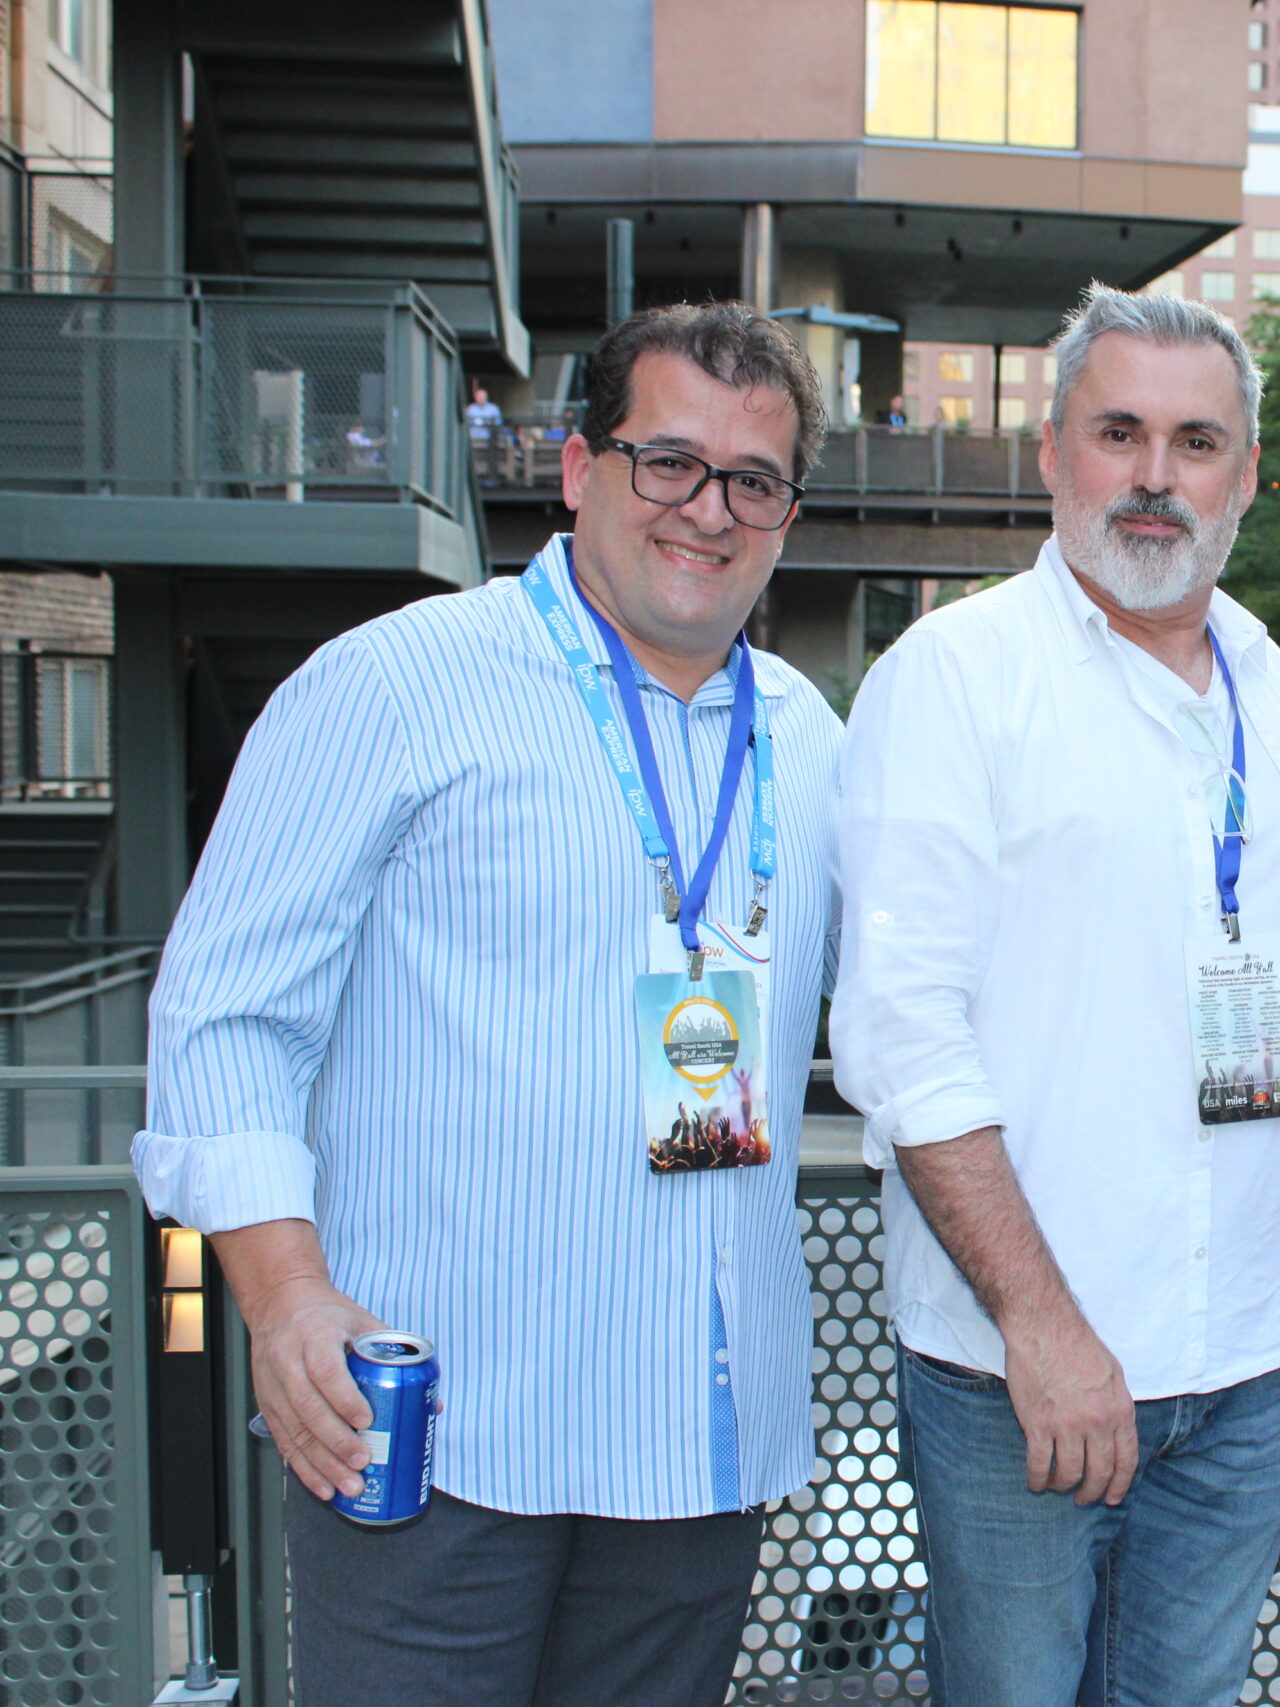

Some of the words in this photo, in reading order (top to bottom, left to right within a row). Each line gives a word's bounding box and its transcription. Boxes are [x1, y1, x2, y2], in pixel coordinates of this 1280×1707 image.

[546, 612, 575, 652] EXPRESS
[551, 604, 583, 650] AMERICAN
[575, 663, 598, 692] ipw
[604, 718, 633, 773] AMERICAN
[627, 788, 648, 817] ipw
[761, 838, 776, 866] ipw
[1198, 963, 1235, 977] Welcome
[1238, 961, 1252, 974] All
[1225, 1095, 1248, 1106] miles
[423, 1413, 435, 1466] LIGHT
[419, 1469, 431, 1505] BUD
